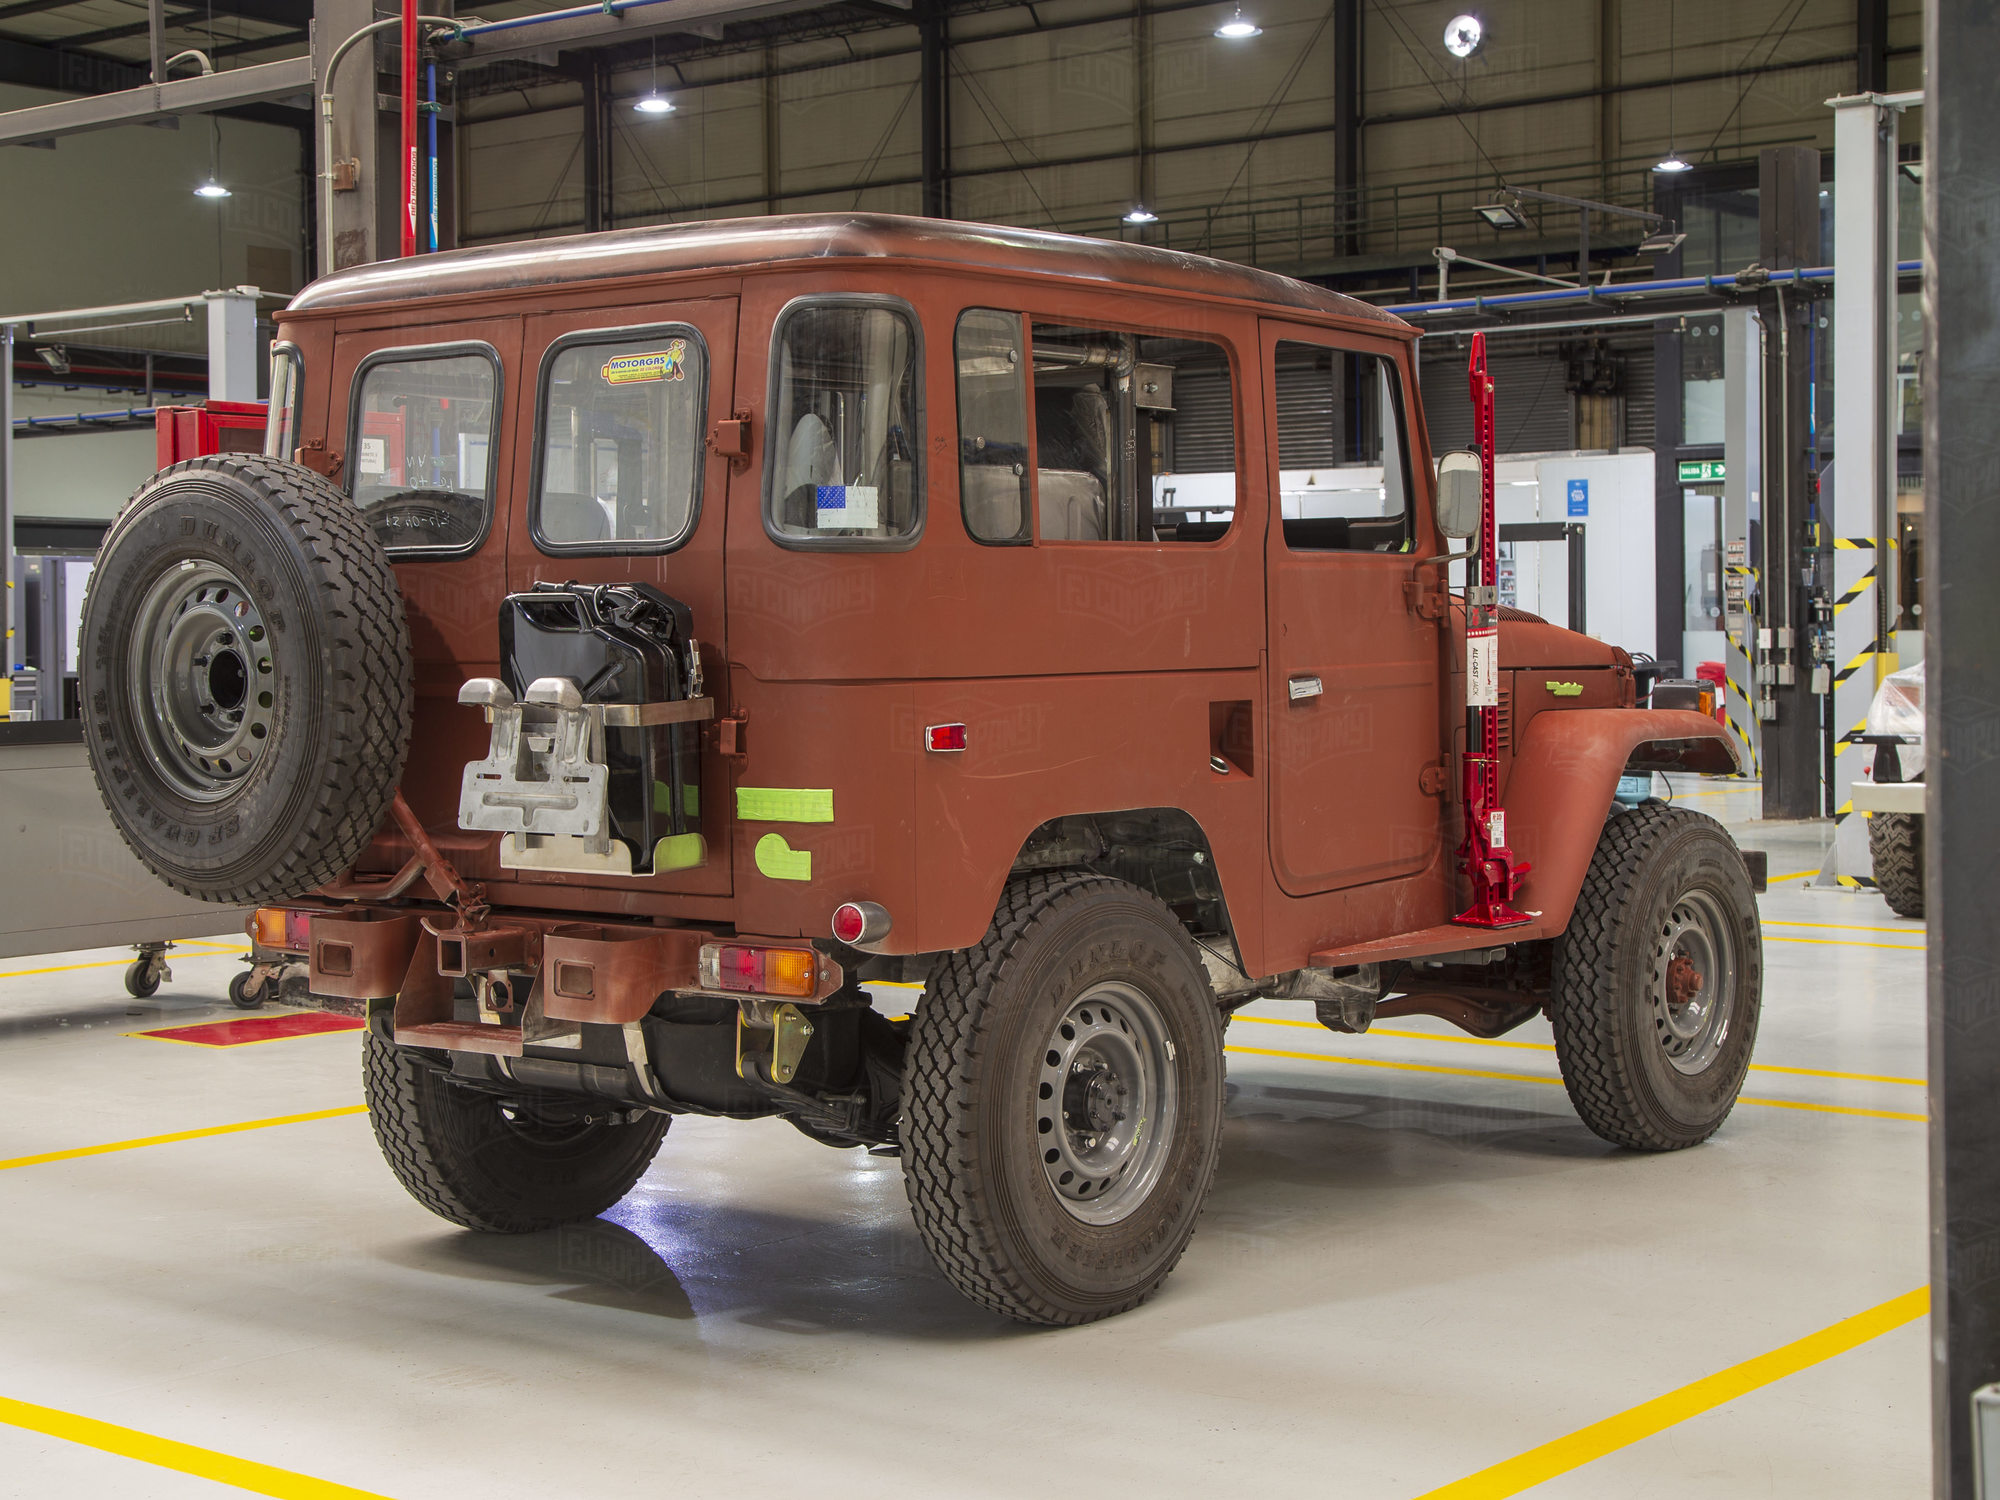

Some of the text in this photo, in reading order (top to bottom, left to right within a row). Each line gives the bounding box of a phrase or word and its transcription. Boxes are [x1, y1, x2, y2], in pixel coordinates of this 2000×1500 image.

[610, 356, 665, 369] MOTORGAS
[1681, 467, 1700, 475] SALIDA
[180, 514, 287, 632] DUNLOP
